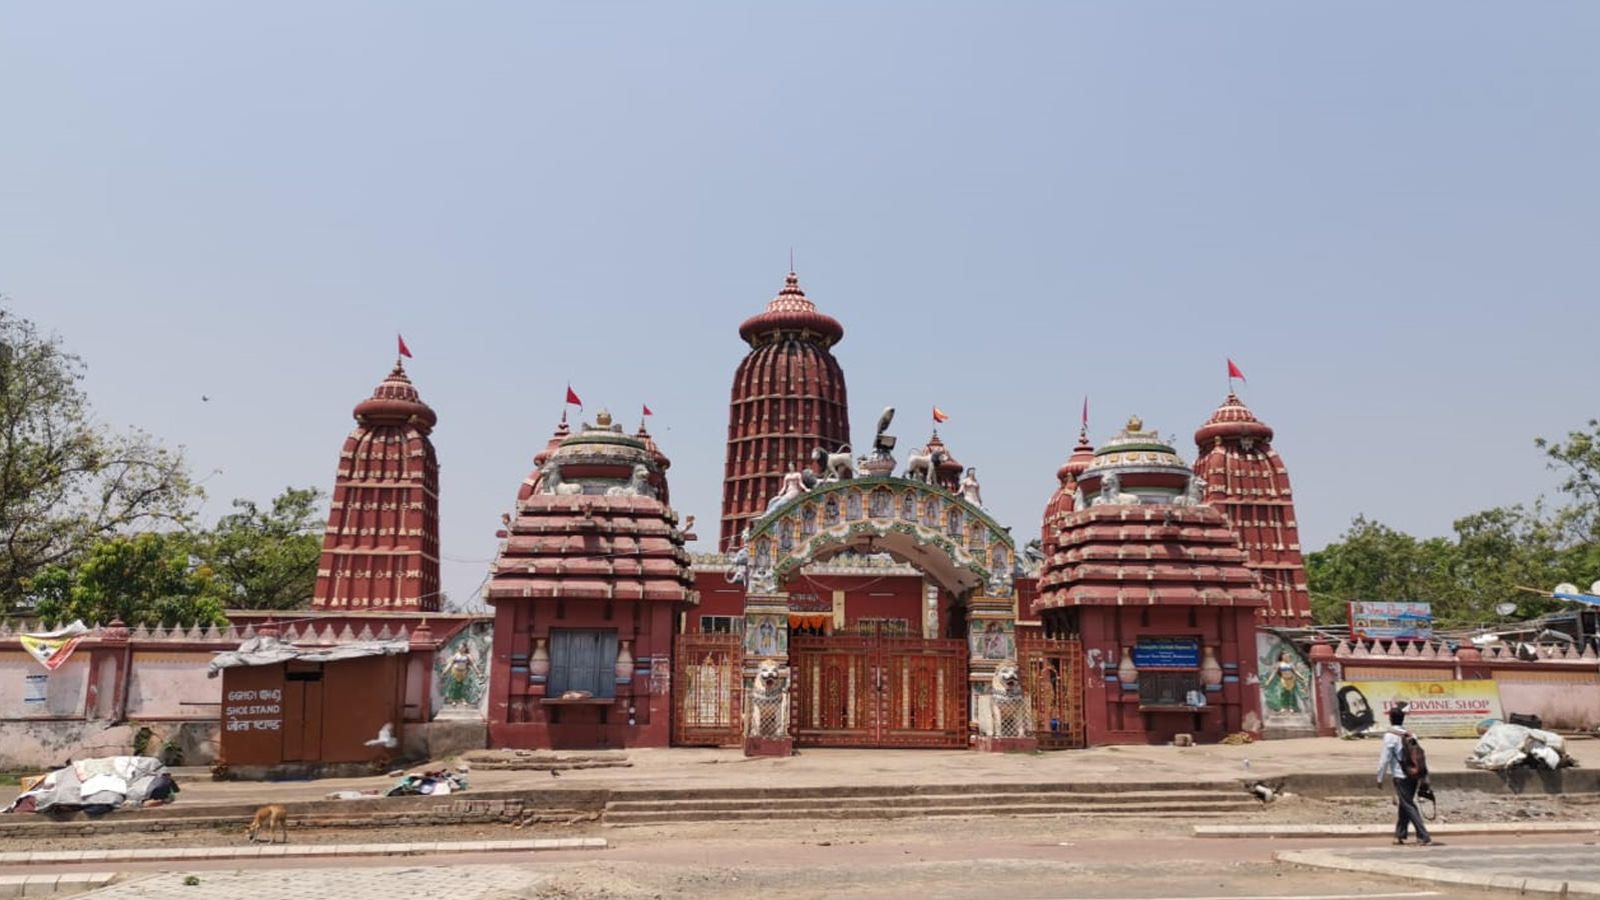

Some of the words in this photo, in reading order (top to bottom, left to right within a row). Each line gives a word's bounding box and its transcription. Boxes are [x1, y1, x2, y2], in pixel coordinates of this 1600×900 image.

[226, 706, 248, 715] SHOE
[249, 705, 280, 714] STAND
[1411, 700, 1453, 711] DIVINE
[1455, 700, 1489, 710] SHOP
